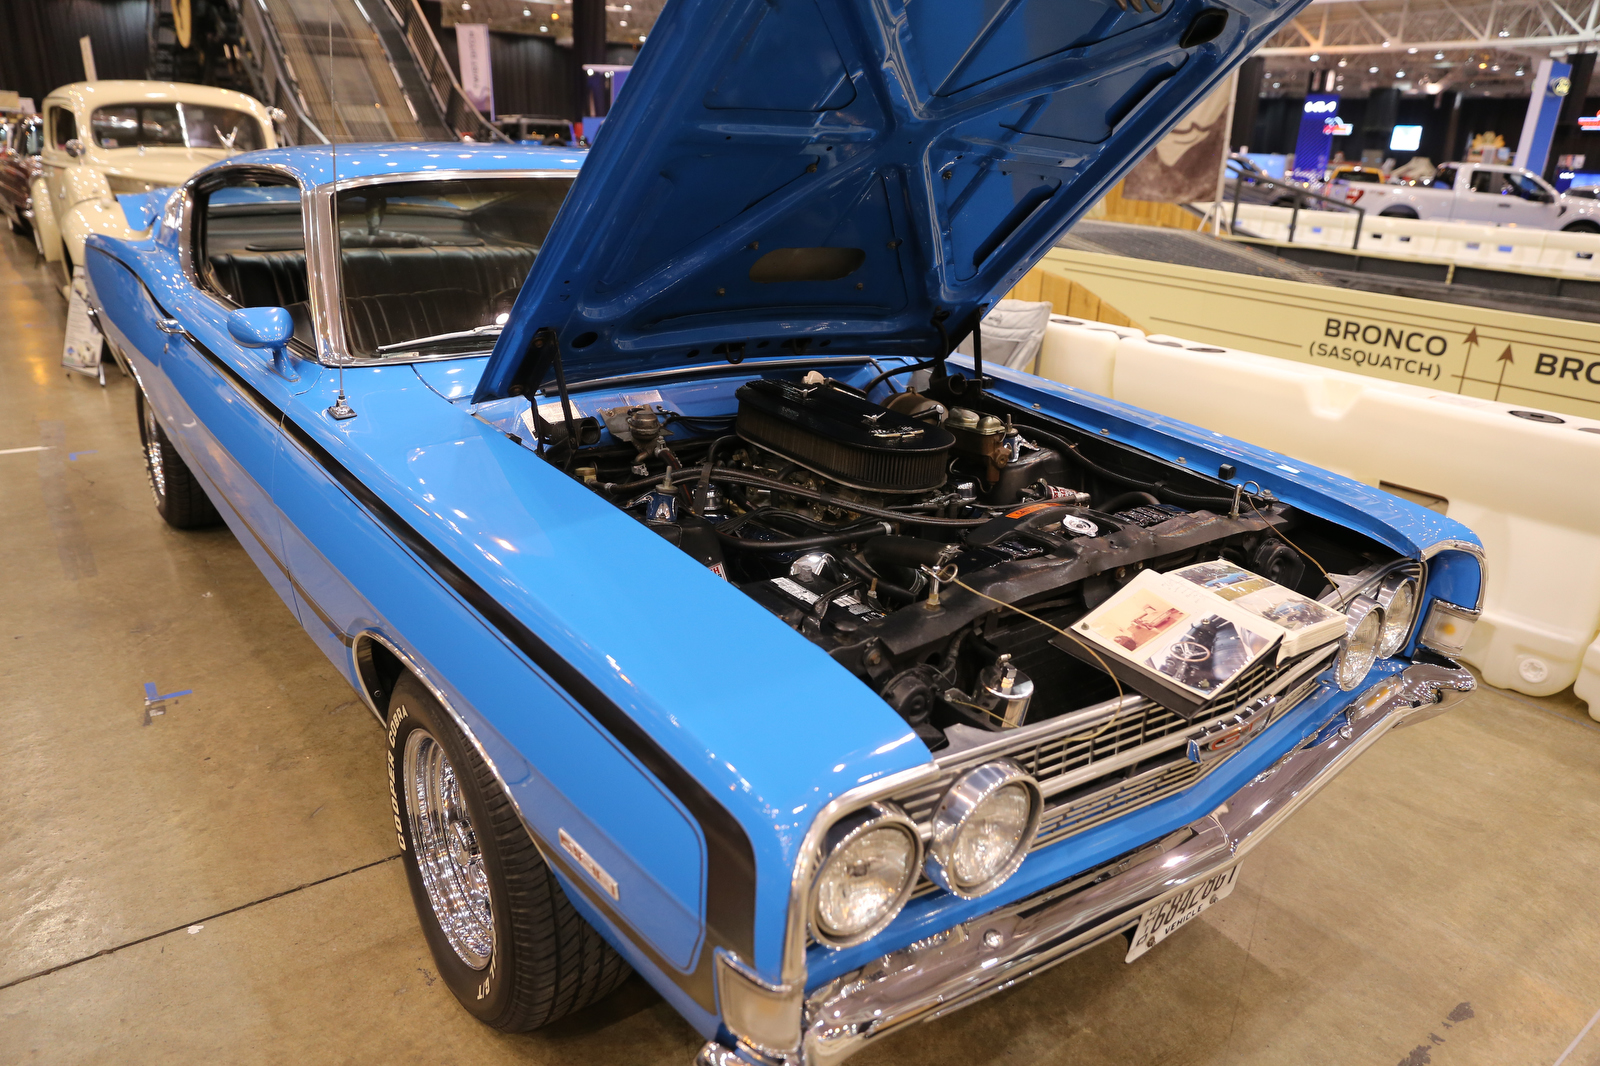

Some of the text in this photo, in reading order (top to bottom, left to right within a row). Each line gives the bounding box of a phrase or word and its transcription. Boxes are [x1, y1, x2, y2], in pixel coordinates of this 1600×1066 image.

[1324, 318, 1447, 356] BRONCO
[1309, 341, 1441, 381] (SASQUATCH)
[387, 704, 408, 851] COOPER COBRA
[1165, 904, 1202, 934] VEHICLE
